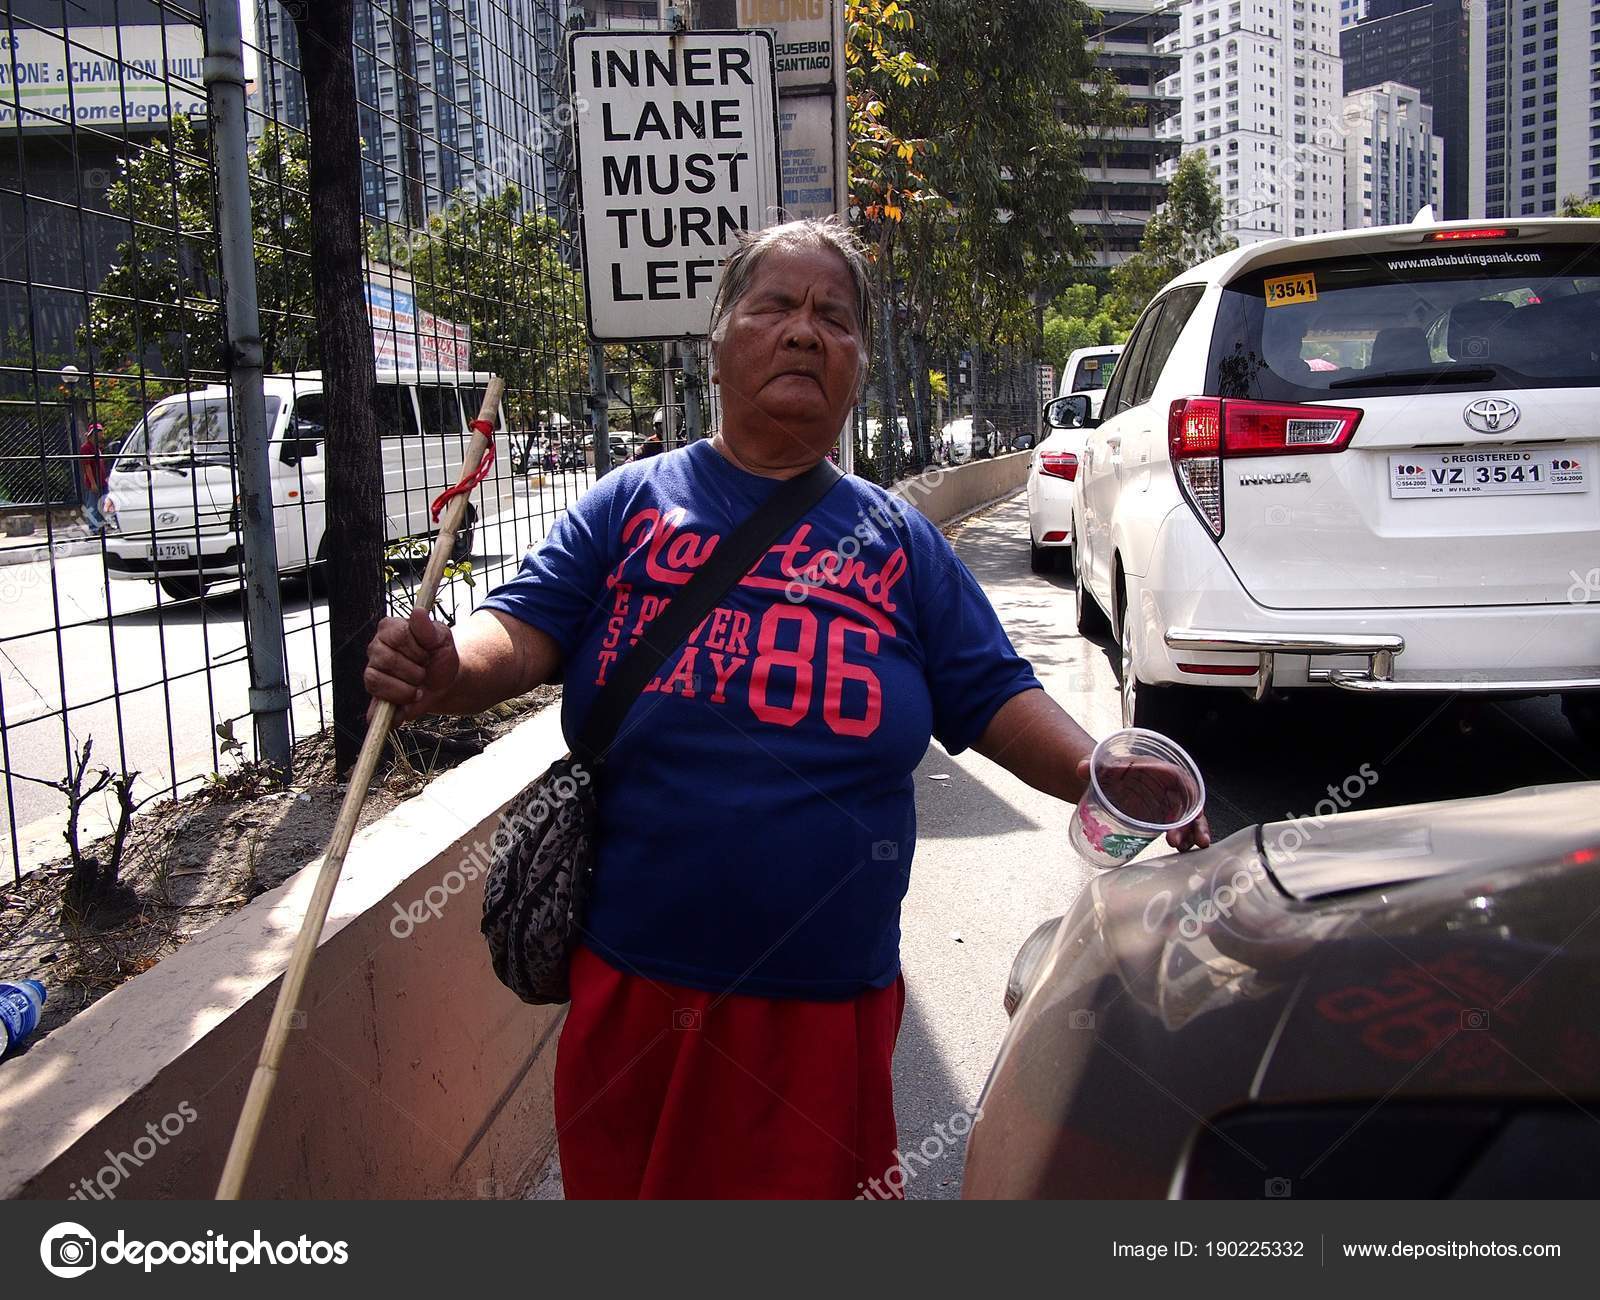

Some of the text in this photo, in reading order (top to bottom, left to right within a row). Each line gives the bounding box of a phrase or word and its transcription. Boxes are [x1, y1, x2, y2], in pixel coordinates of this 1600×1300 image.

[0, 35, 20, 50] es
[775, 41, 830, 56] EUSEBIO
[56, 68, 64, 81] a
[70, 59, 157, 82] CHAMION
[163, 57, 204, 79] UIL
[591, 48, 754, 88] INNER
[777, 56, 830, 72] SANTIAGO
[602, 100, 743, 141] LANE
[602, 153, 748, 196] MUST
[606, 205, 748, 248] TURN
[1388, 252, 1541, 270] www.mabubutinganak.com
[611, 260, 725, 302] LEF
[1276, 279, 1314, 298] 3541
[1452, 454, 1520, 463] REGISTERED
[1239, 472, 1311, 486] INNOVA
[1432, 468, 1464, 484] VZ
[1476, 465, 1540, 484] 3541
[632, 595, 751, 656] PER
[748, 603, 882, 738] 86
